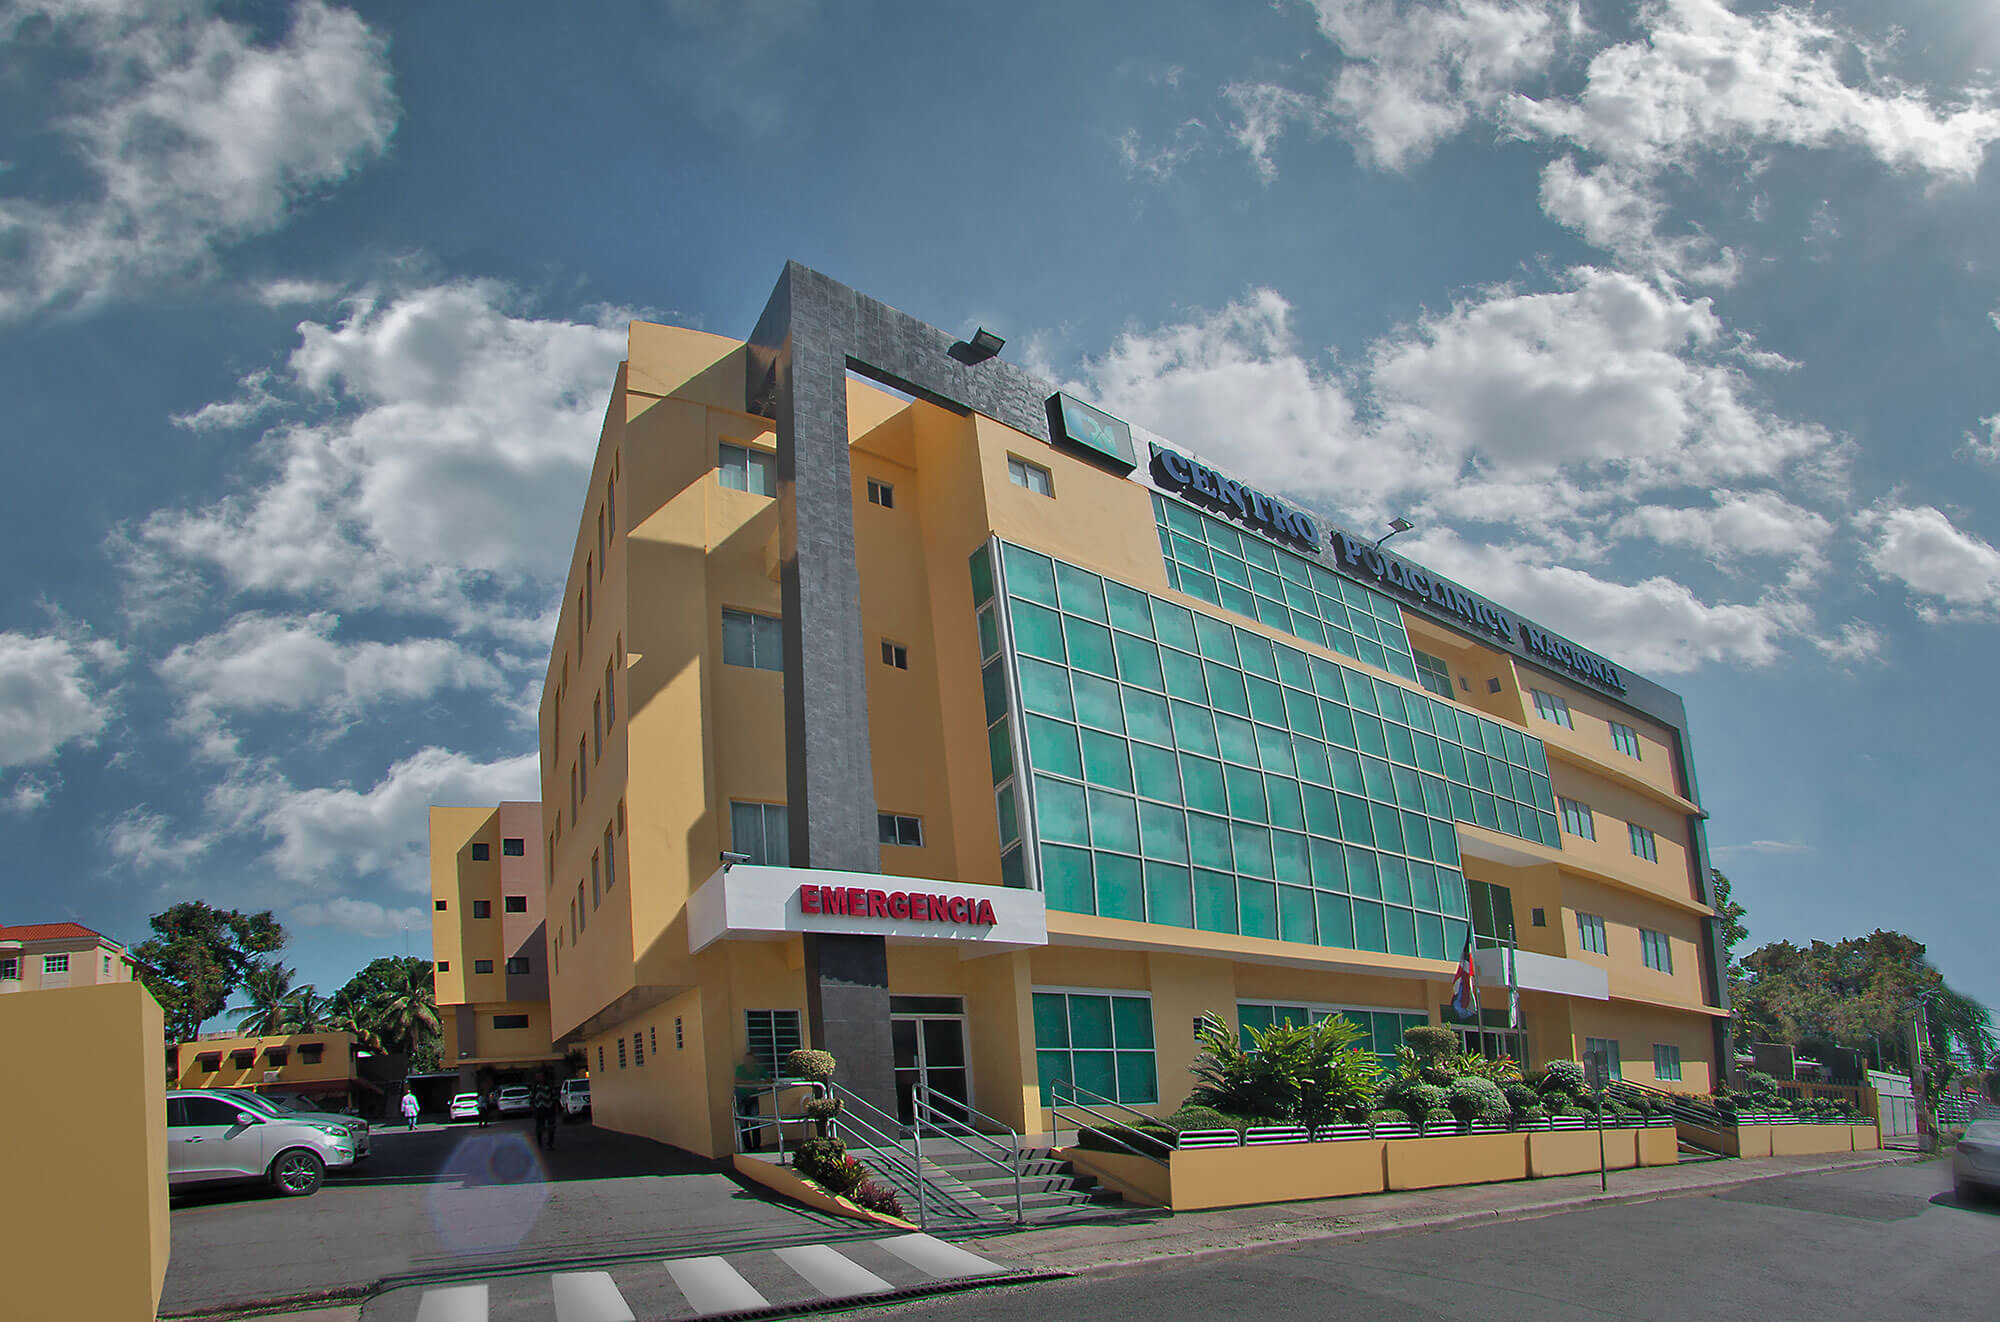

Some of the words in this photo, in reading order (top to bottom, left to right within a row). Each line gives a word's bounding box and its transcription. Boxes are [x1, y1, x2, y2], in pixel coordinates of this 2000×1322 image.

[1160, 449, 1320, 545] CENTRO
[1338, 532, 1515, 638] POLICLINICO
[1526, 624, 1627, 691] NACIONAL
[801, 884, 998, 926] EMERGENCIA
